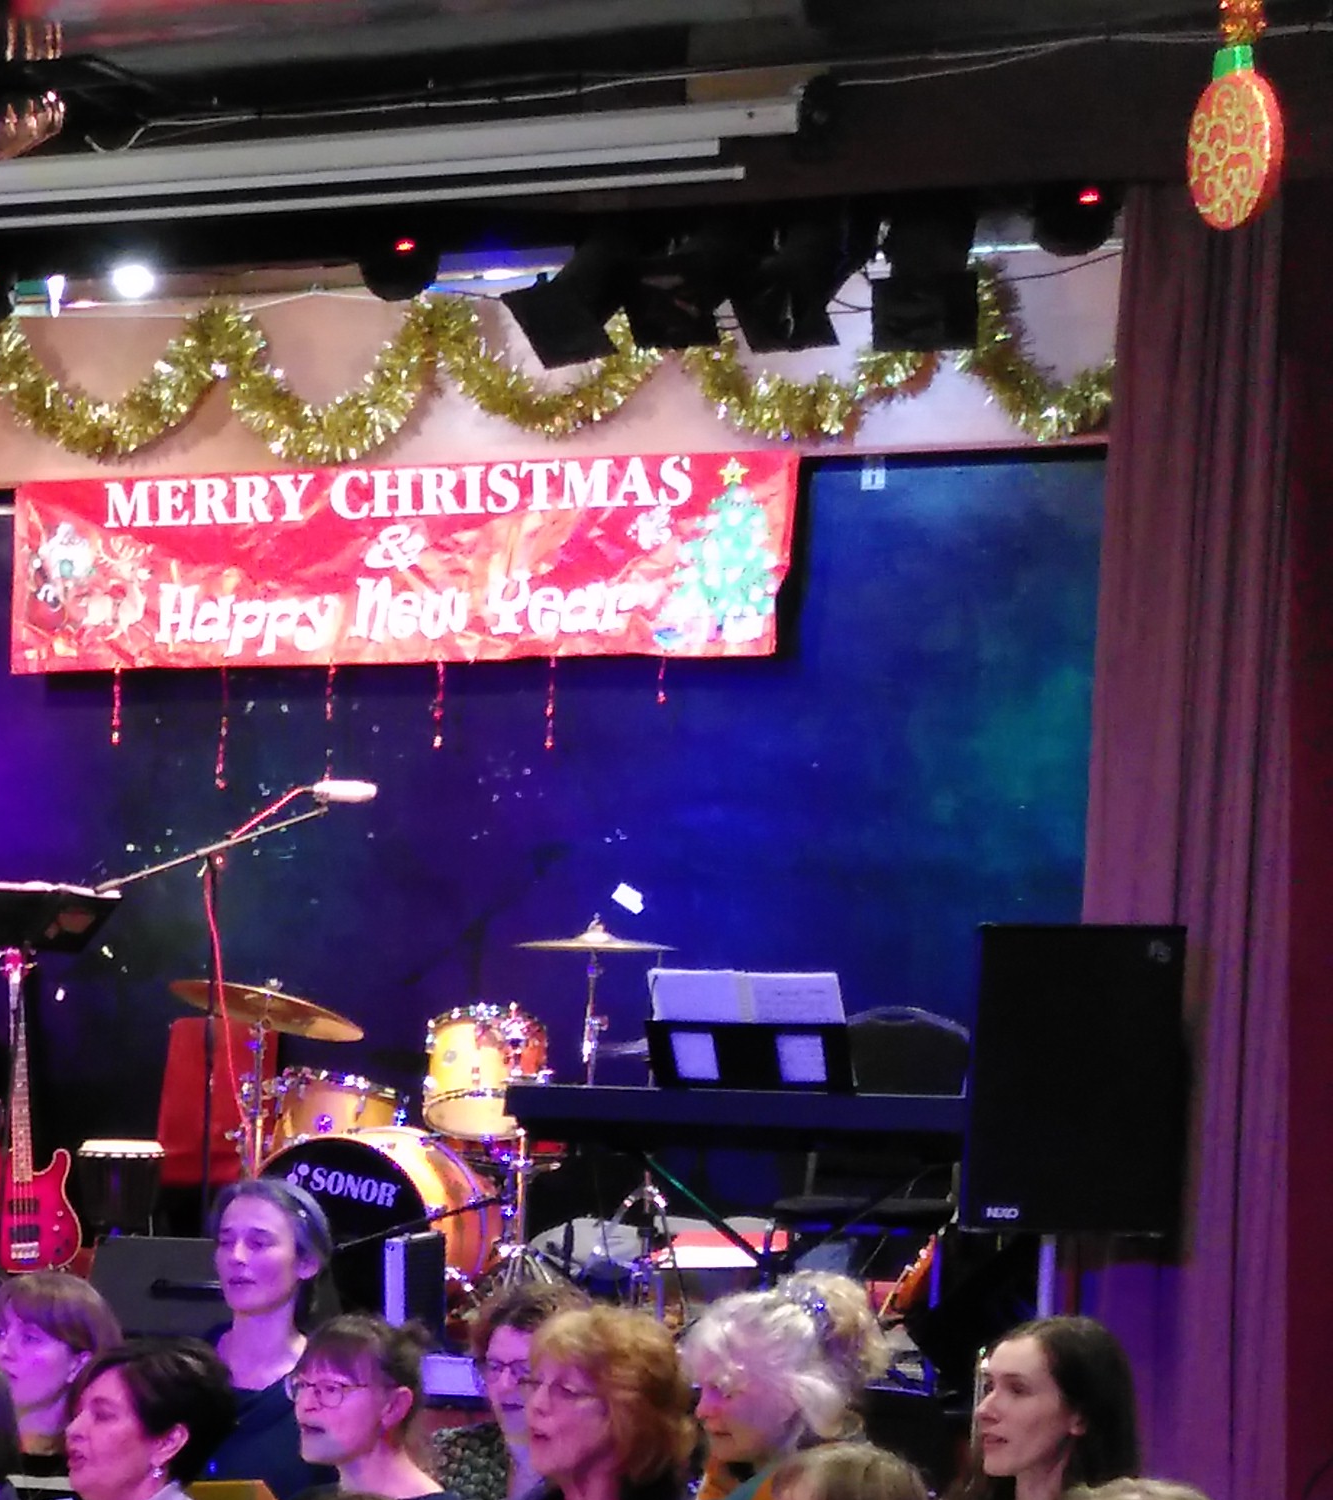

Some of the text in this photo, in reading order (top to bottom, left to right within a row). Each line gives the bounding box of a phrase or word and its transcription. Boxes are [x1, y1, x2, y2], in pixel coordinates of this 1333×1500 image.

[103, 455, 693, 529] MERRY CHRISTMAS
[364, 524, 426, 572] &
[155, 573, 645, 657] Happy New Year
[309, 1167, 398, 1208] SONOR
